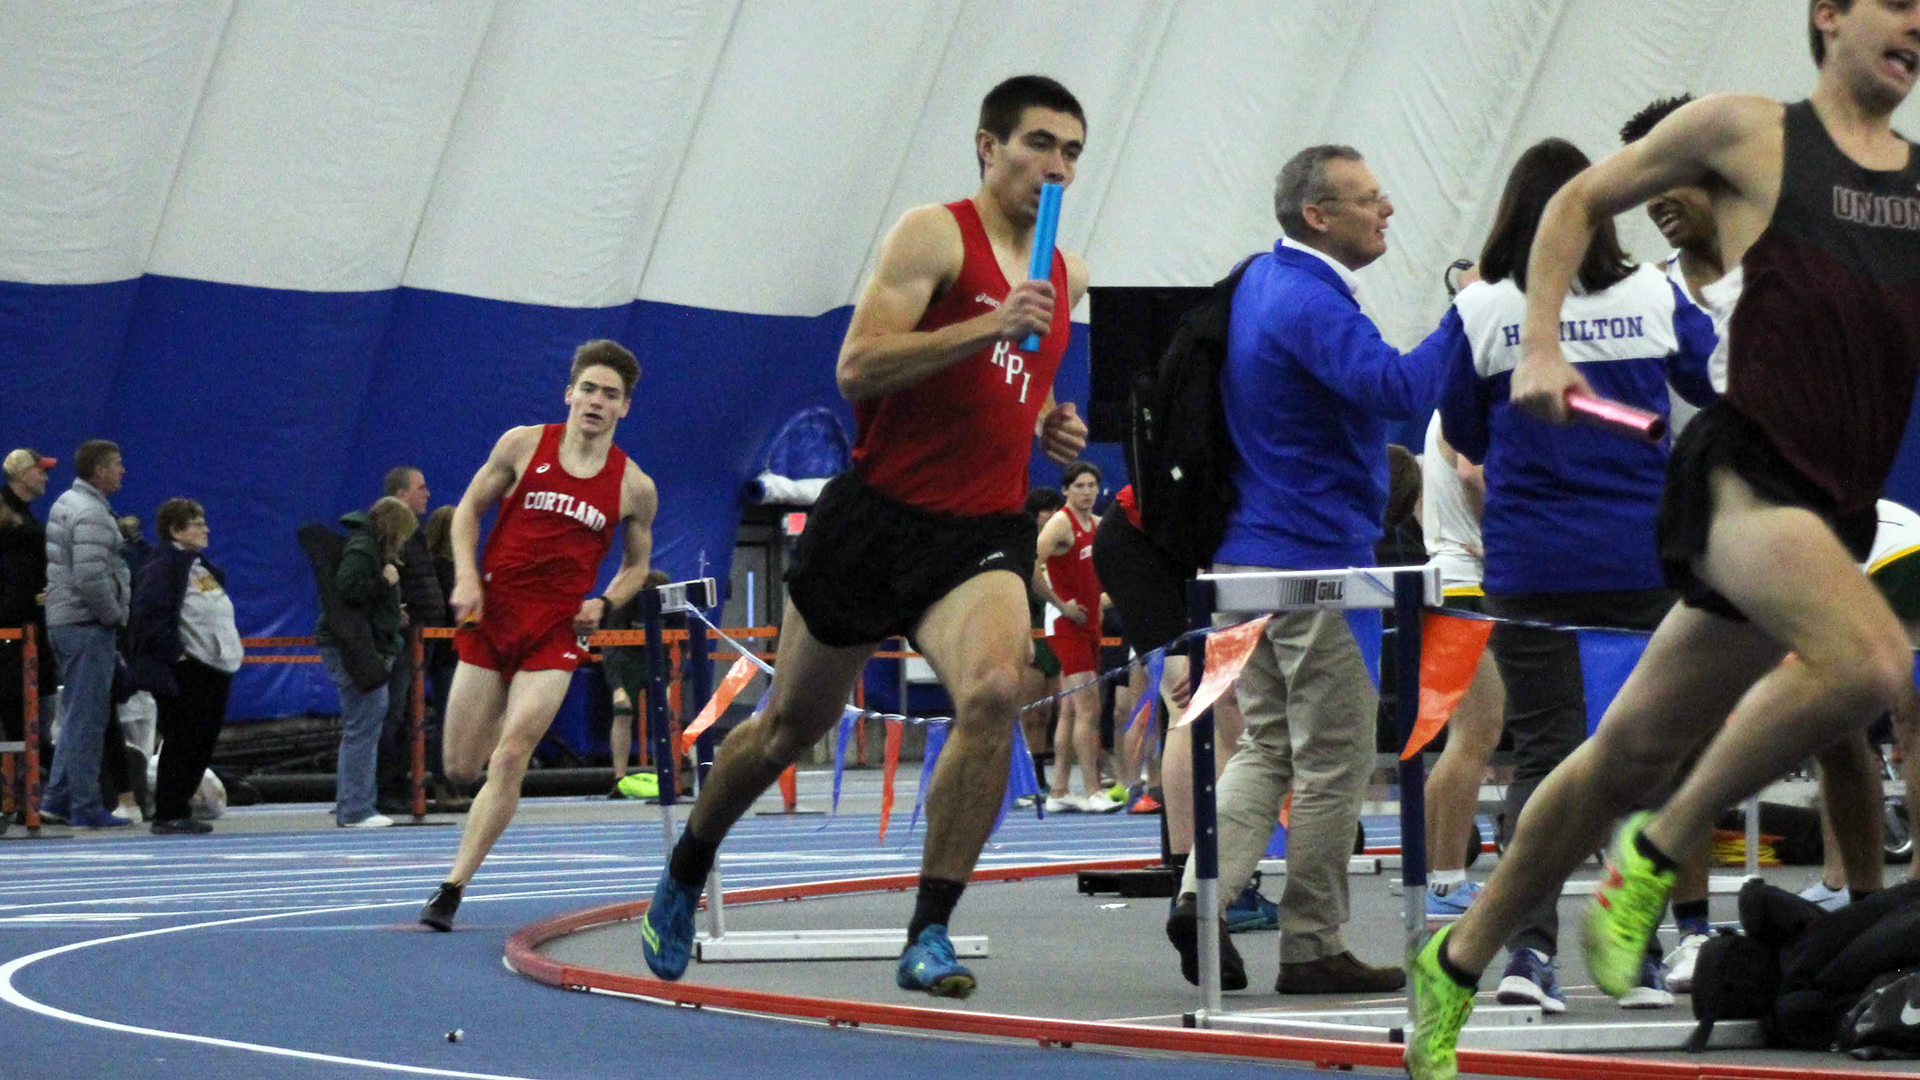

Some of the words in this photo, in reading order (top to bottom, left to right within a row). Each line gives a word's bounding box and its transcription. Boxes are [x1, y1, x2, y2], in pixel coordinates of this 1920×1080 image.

[1833, 186, 1920, 230] UNION
[1502, 316, 1644, 347] HILTON
[990, 340, 1031, 404] RPI
[524, 491, 607, 531] CORTLAND
[1317, 581, 1343, 600] GILL
